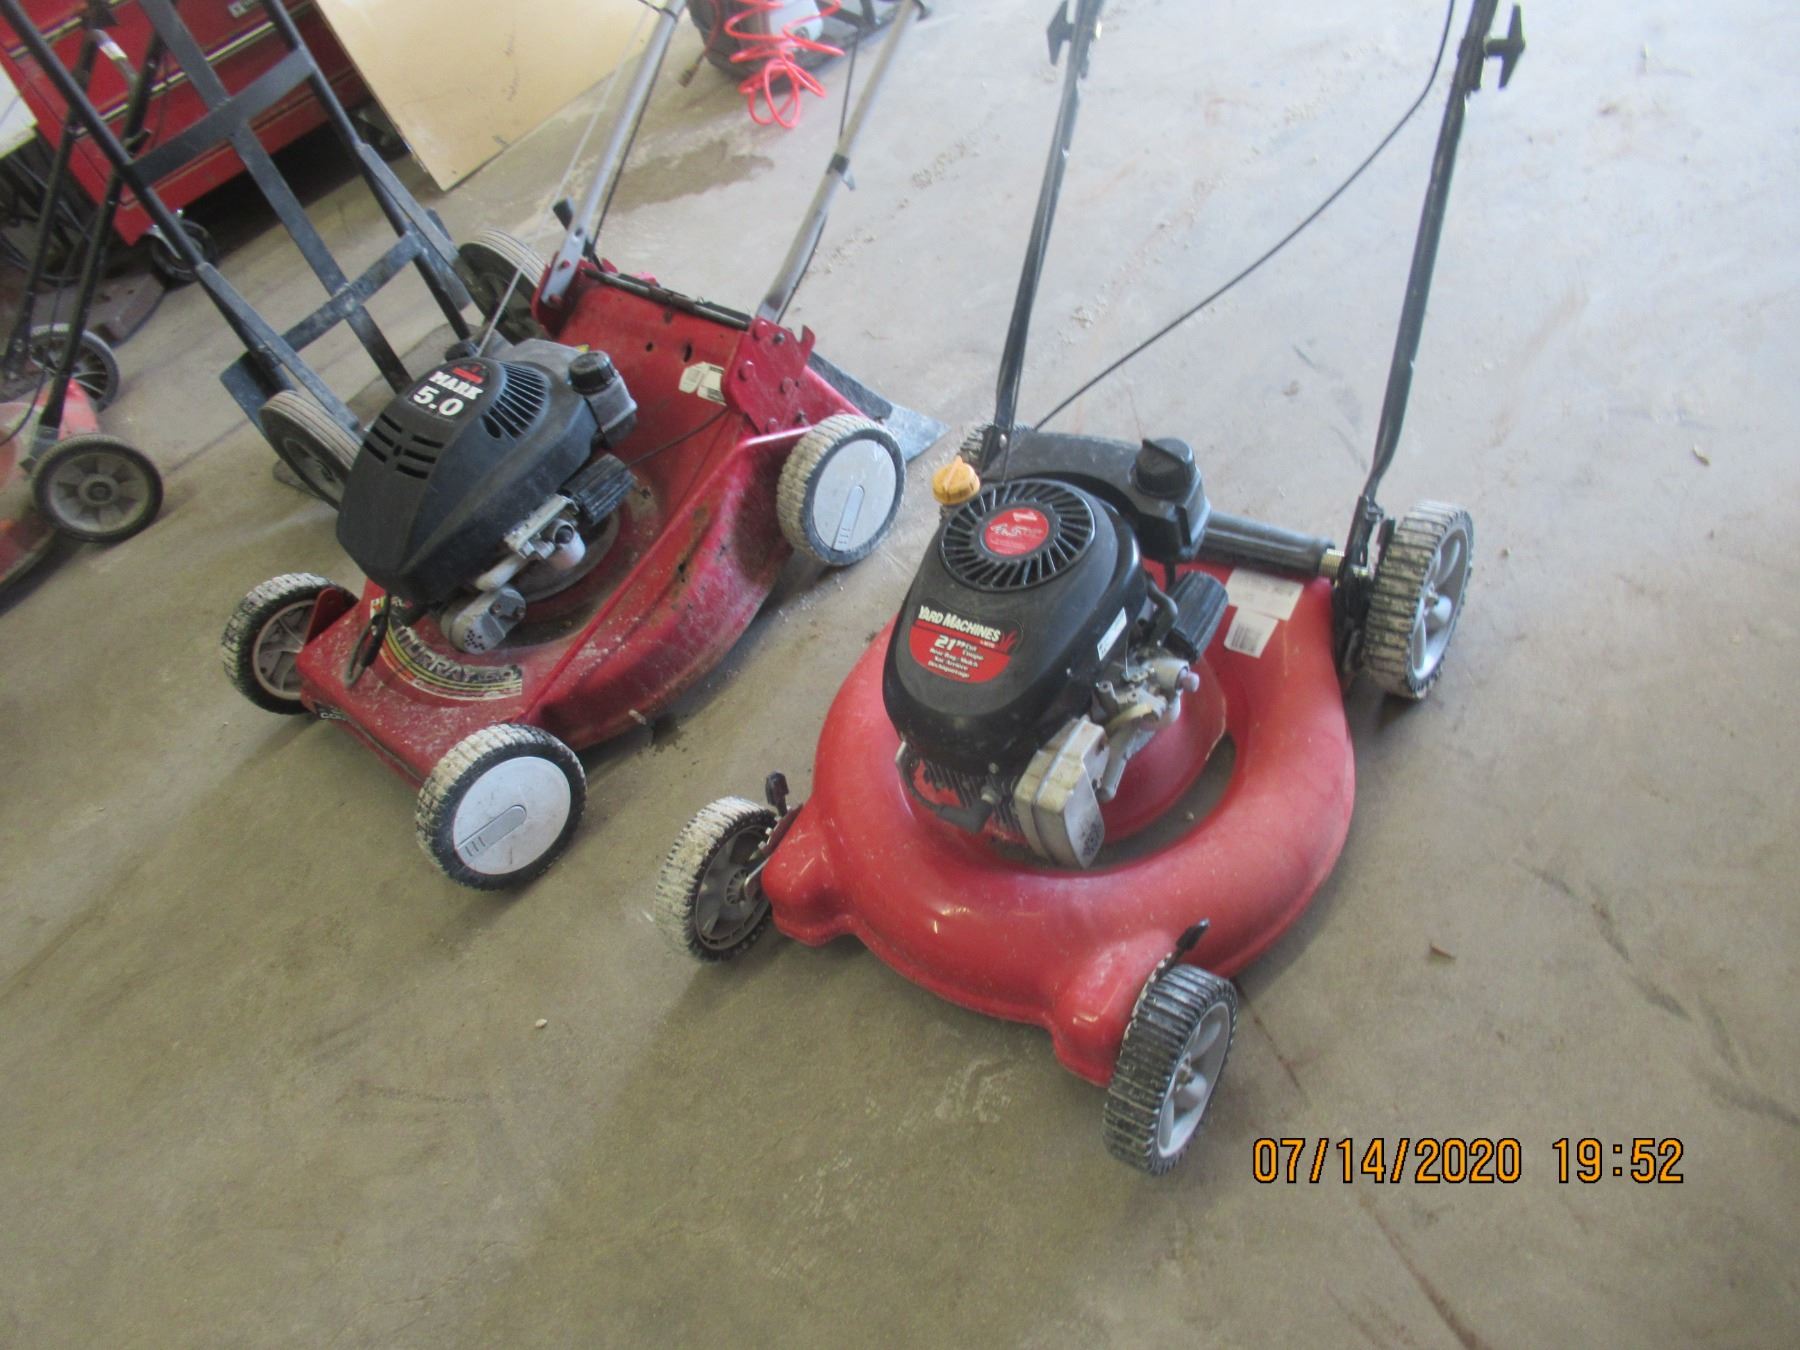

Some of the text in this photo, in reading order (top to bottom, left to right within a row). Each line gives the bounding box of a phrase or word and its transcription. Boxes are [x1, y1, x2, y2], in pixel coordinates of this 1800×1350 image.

[413, 385, 465, 416] 5.0
[428, 371, 484, 400] MARK
[918, 605, 1001, 643] YARD MACHINES
